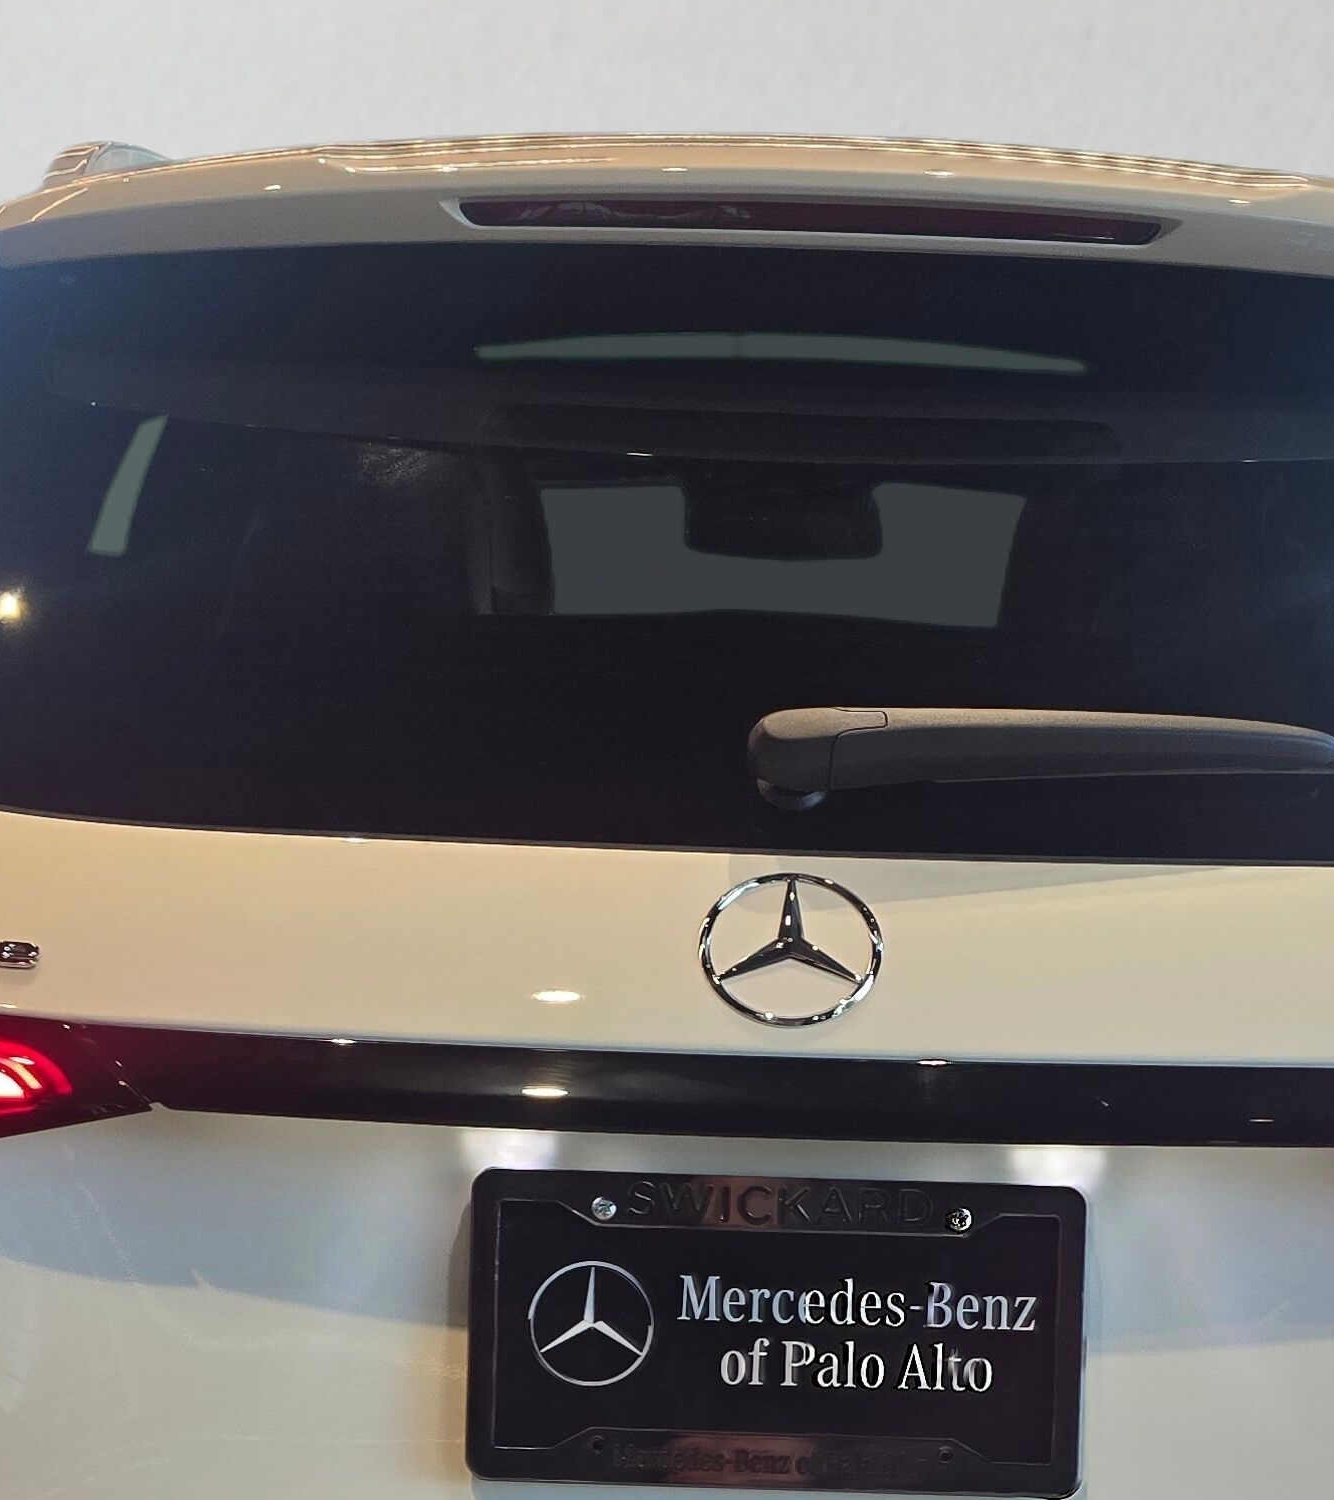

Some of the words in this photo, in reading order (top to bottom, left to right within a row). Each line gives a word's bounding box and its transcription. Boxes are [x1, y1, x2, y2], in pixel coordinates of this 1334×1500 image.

[626, 1180, 936, 1225] SWICKARD
[677, 1274, 1037, 1332] Mercedes-Benz
[720, 1339, 769, 1387] of
[781, 1340, 885, 1390] Palo
[898, 1342, 993, 1393] Alto
